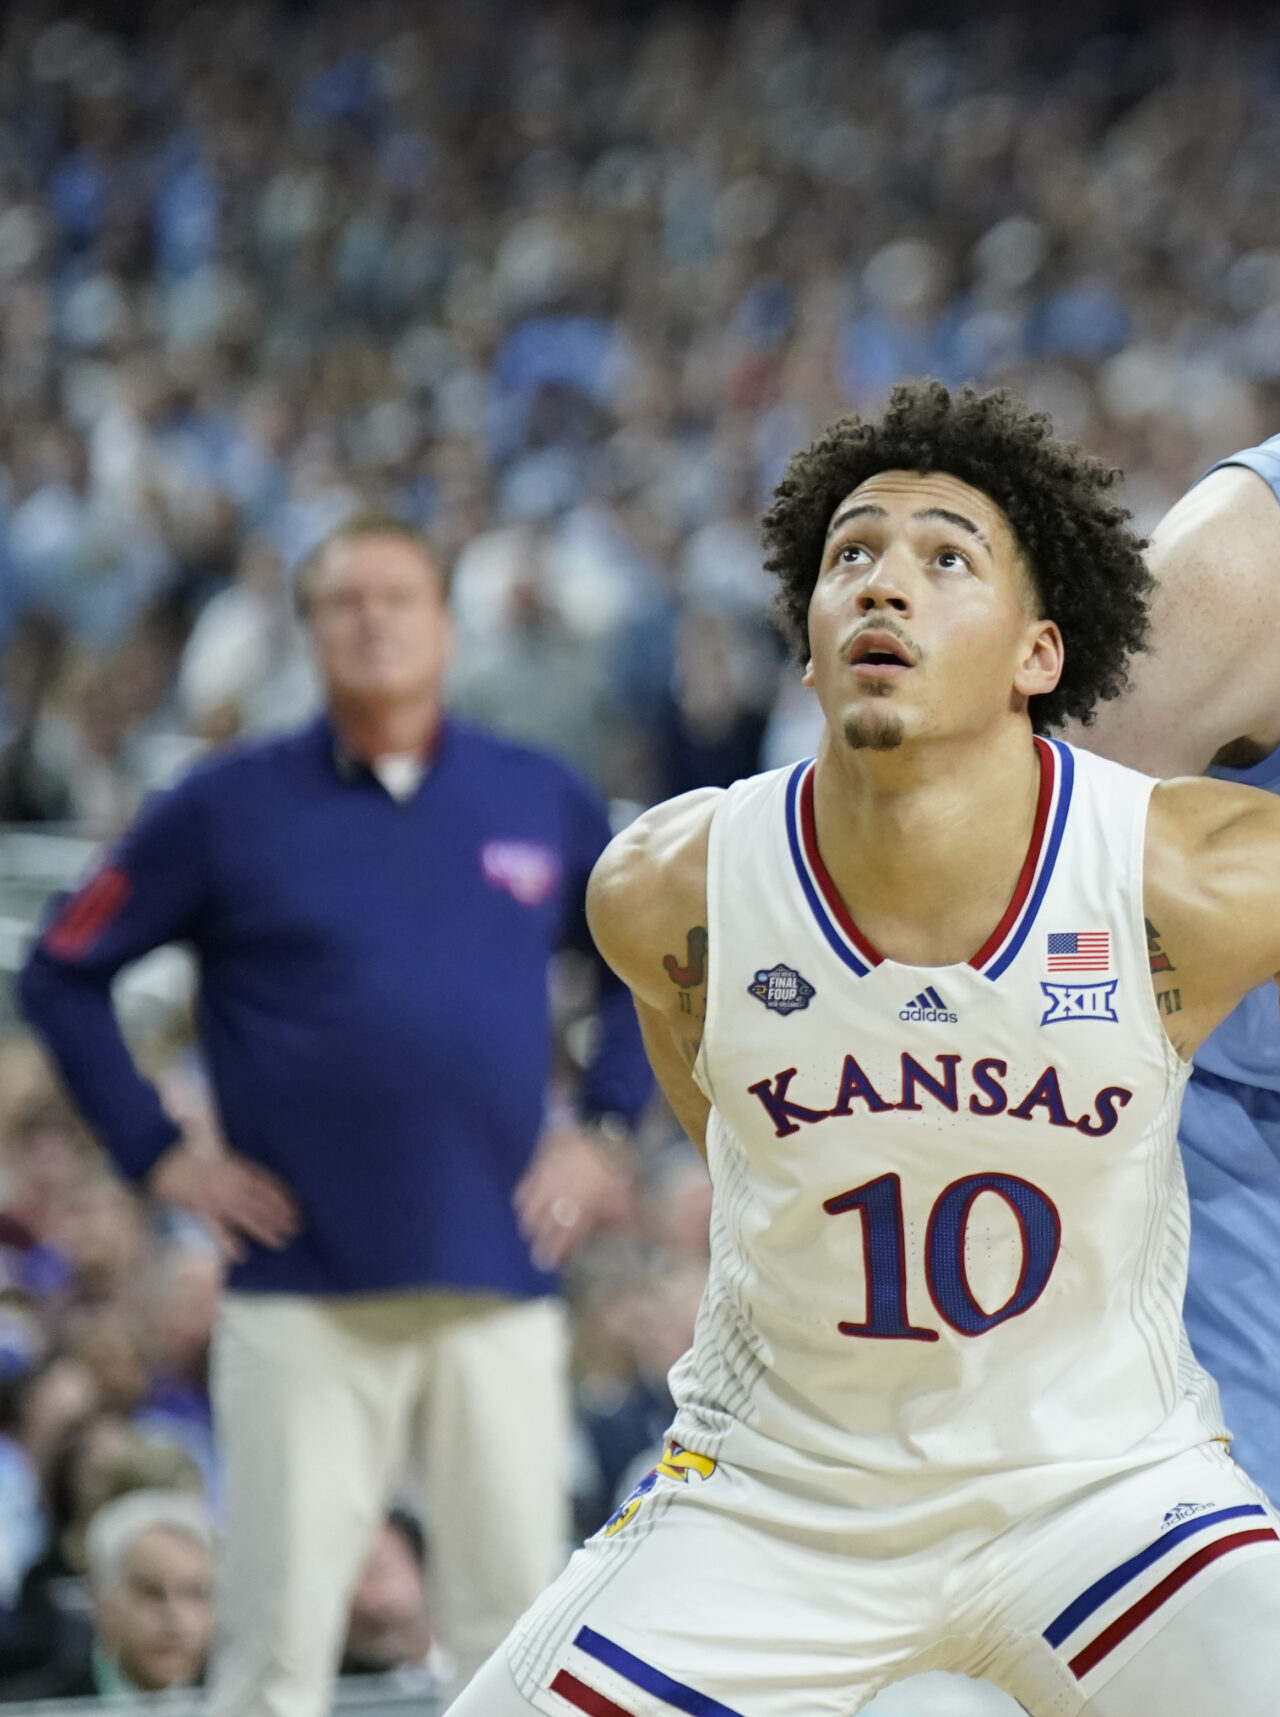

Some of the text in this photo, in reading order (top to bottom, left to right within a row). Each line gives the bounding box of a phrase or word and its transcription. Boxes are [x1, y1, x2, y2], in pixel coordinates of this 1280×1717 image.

[768, 977, 799, 989] FINAL
[767, 988, 798, 1001] FOUR
[899, 1007, 958, 1023] adidas
[748, 1052, 1133, 1138] KANSAS
[823, 1171, 1062, 1343] 10
